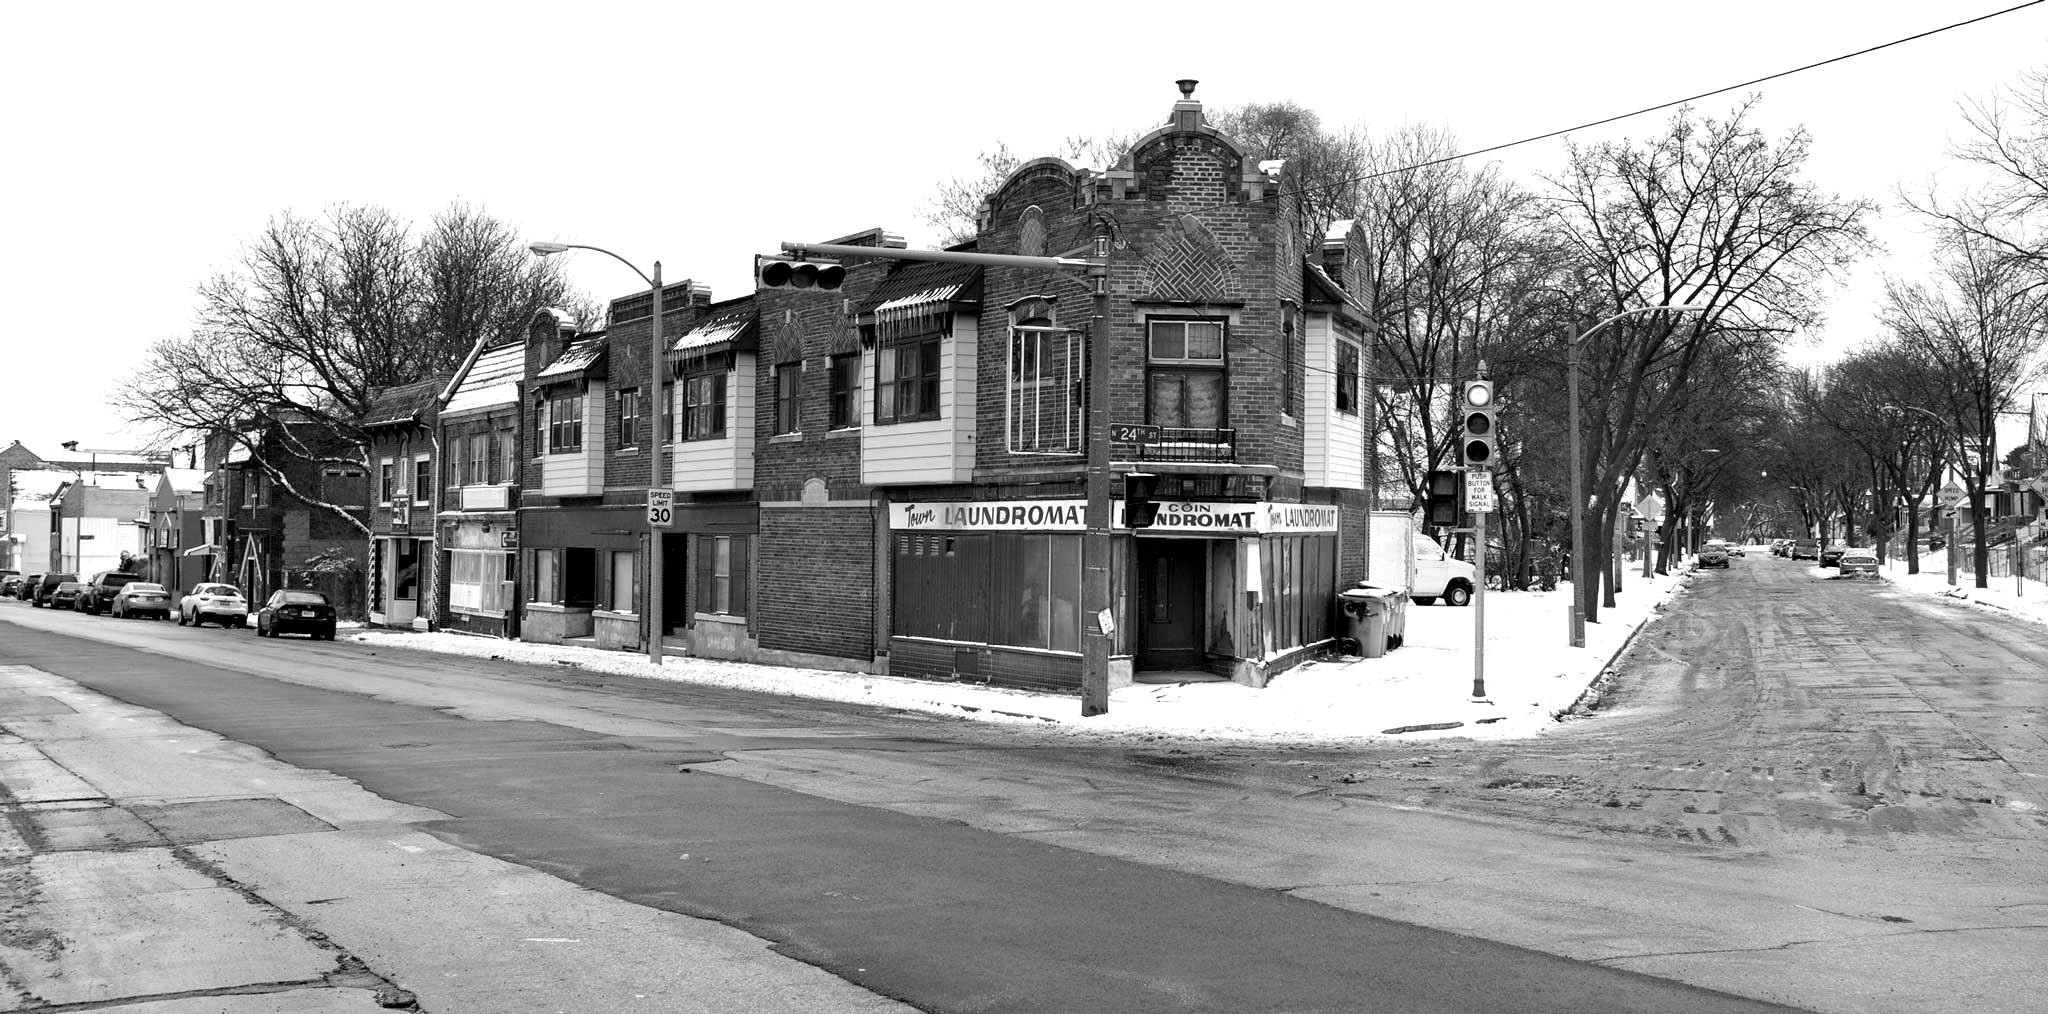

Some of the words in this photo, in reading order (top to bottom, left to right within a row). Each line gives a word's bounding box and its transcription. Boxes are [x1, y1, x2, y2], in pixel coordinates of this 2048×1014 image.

[1111, 429, 1117, 437] N
[1120, 427, 1146, 440] 24TH
[1148, 431, 1157, 439] ST
[650, 508, 670, 522] 30
[904, 504, 935, 527] Town
[944, 505, 1088, 526] LAUNDROMAT
[1168, 503, 1211, 513] COIN
[1121, 507, 1256, 528] NDROMAT
[1284, 508, 1336, 527] LAUNDROMAT
